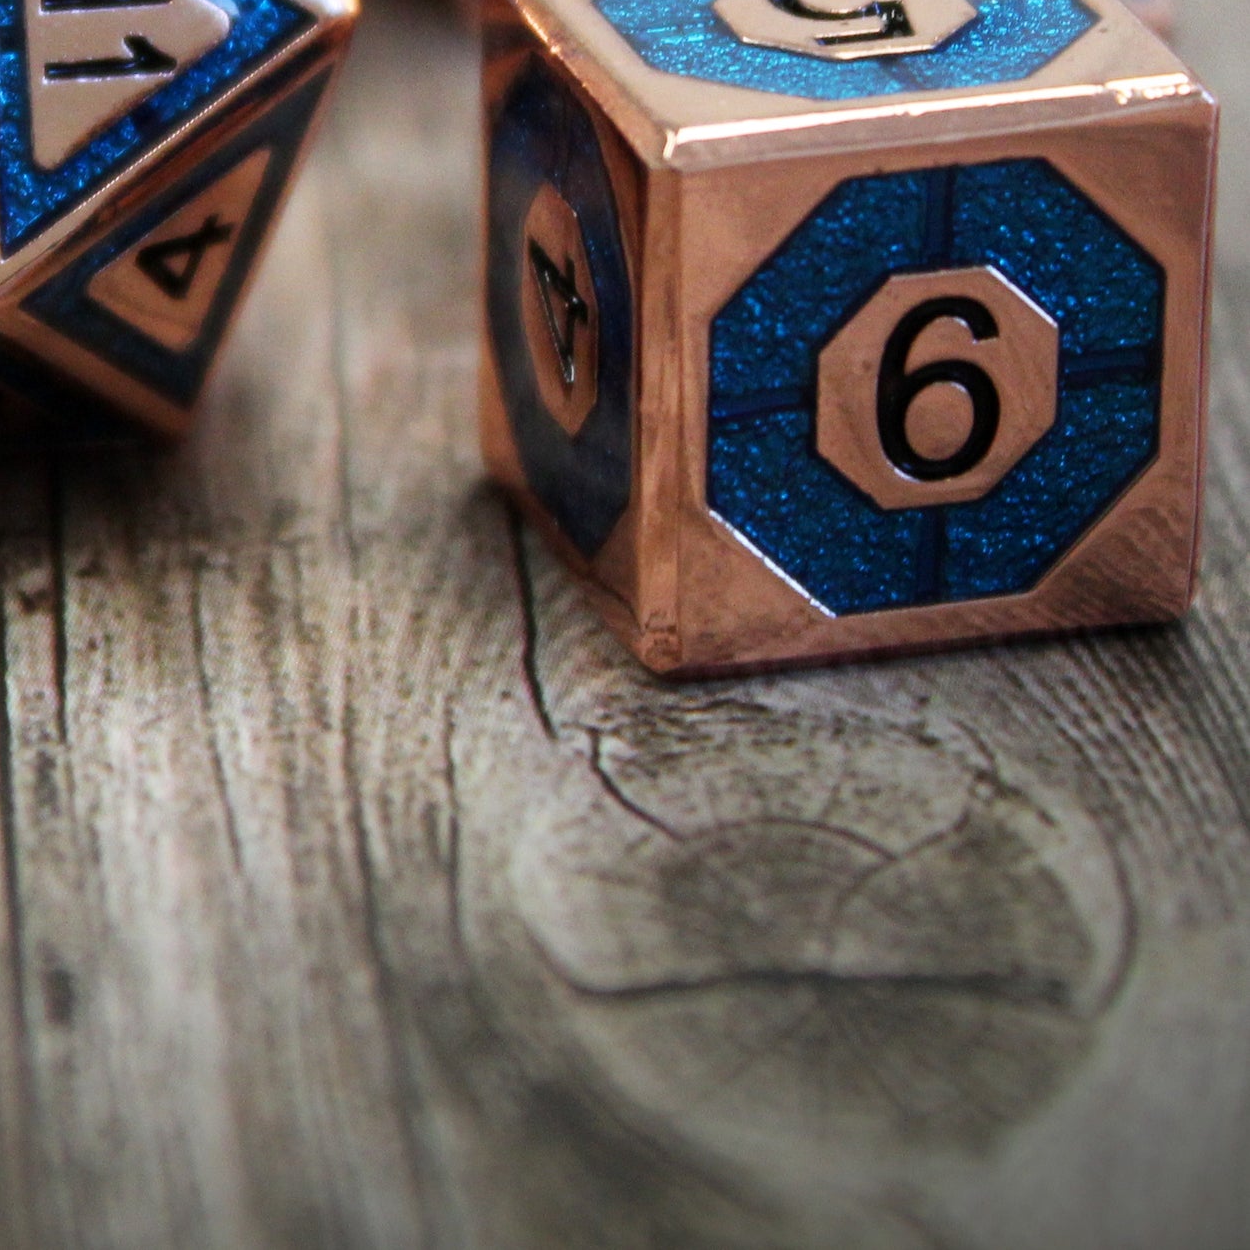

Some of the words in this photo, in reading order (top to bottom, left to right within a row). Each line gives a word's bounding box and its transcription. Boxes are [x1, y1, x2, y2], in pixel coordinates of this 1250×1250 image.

[135, 214, 235, 299] 4
[528, 237, 589, 385] 4
[875, 295, 1001, 482] 6
